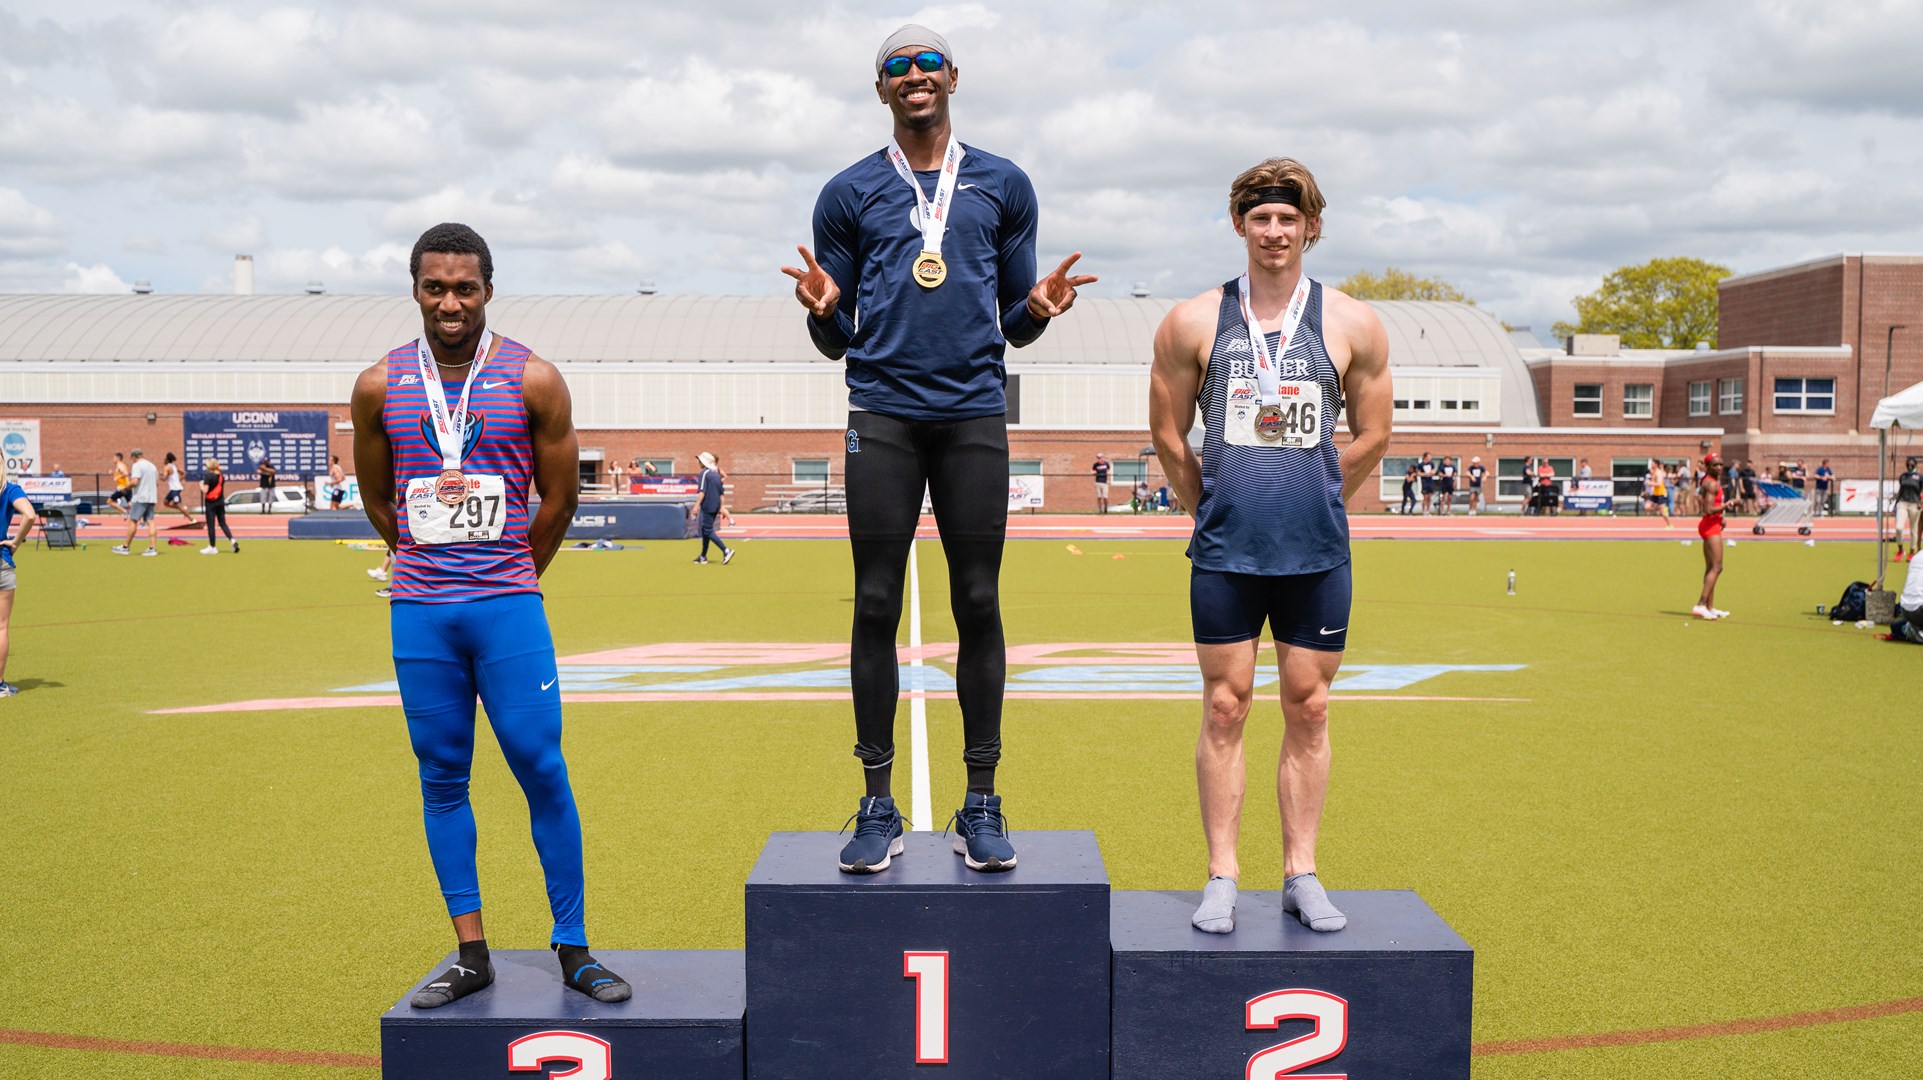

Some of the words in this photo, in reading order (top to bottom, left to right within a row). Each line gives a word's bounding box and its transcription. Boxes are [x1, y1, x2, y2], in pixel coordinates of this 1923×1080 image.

[937, 187, 946, 207] EAST
[934, 205, 942, 220] BIG
[1229, 360, 1310, 378] BUER
[232, 412, 279, 424] UCONN
[432, 399, 442, 421] EAST
[1286, 402, 1316, 434] 46
[6, 458, 34, 470] 017
[449, 495, 500, 529] 297
[904, 951, 949, 1064] 1
[1245, 988, 1348, 1080] 2
